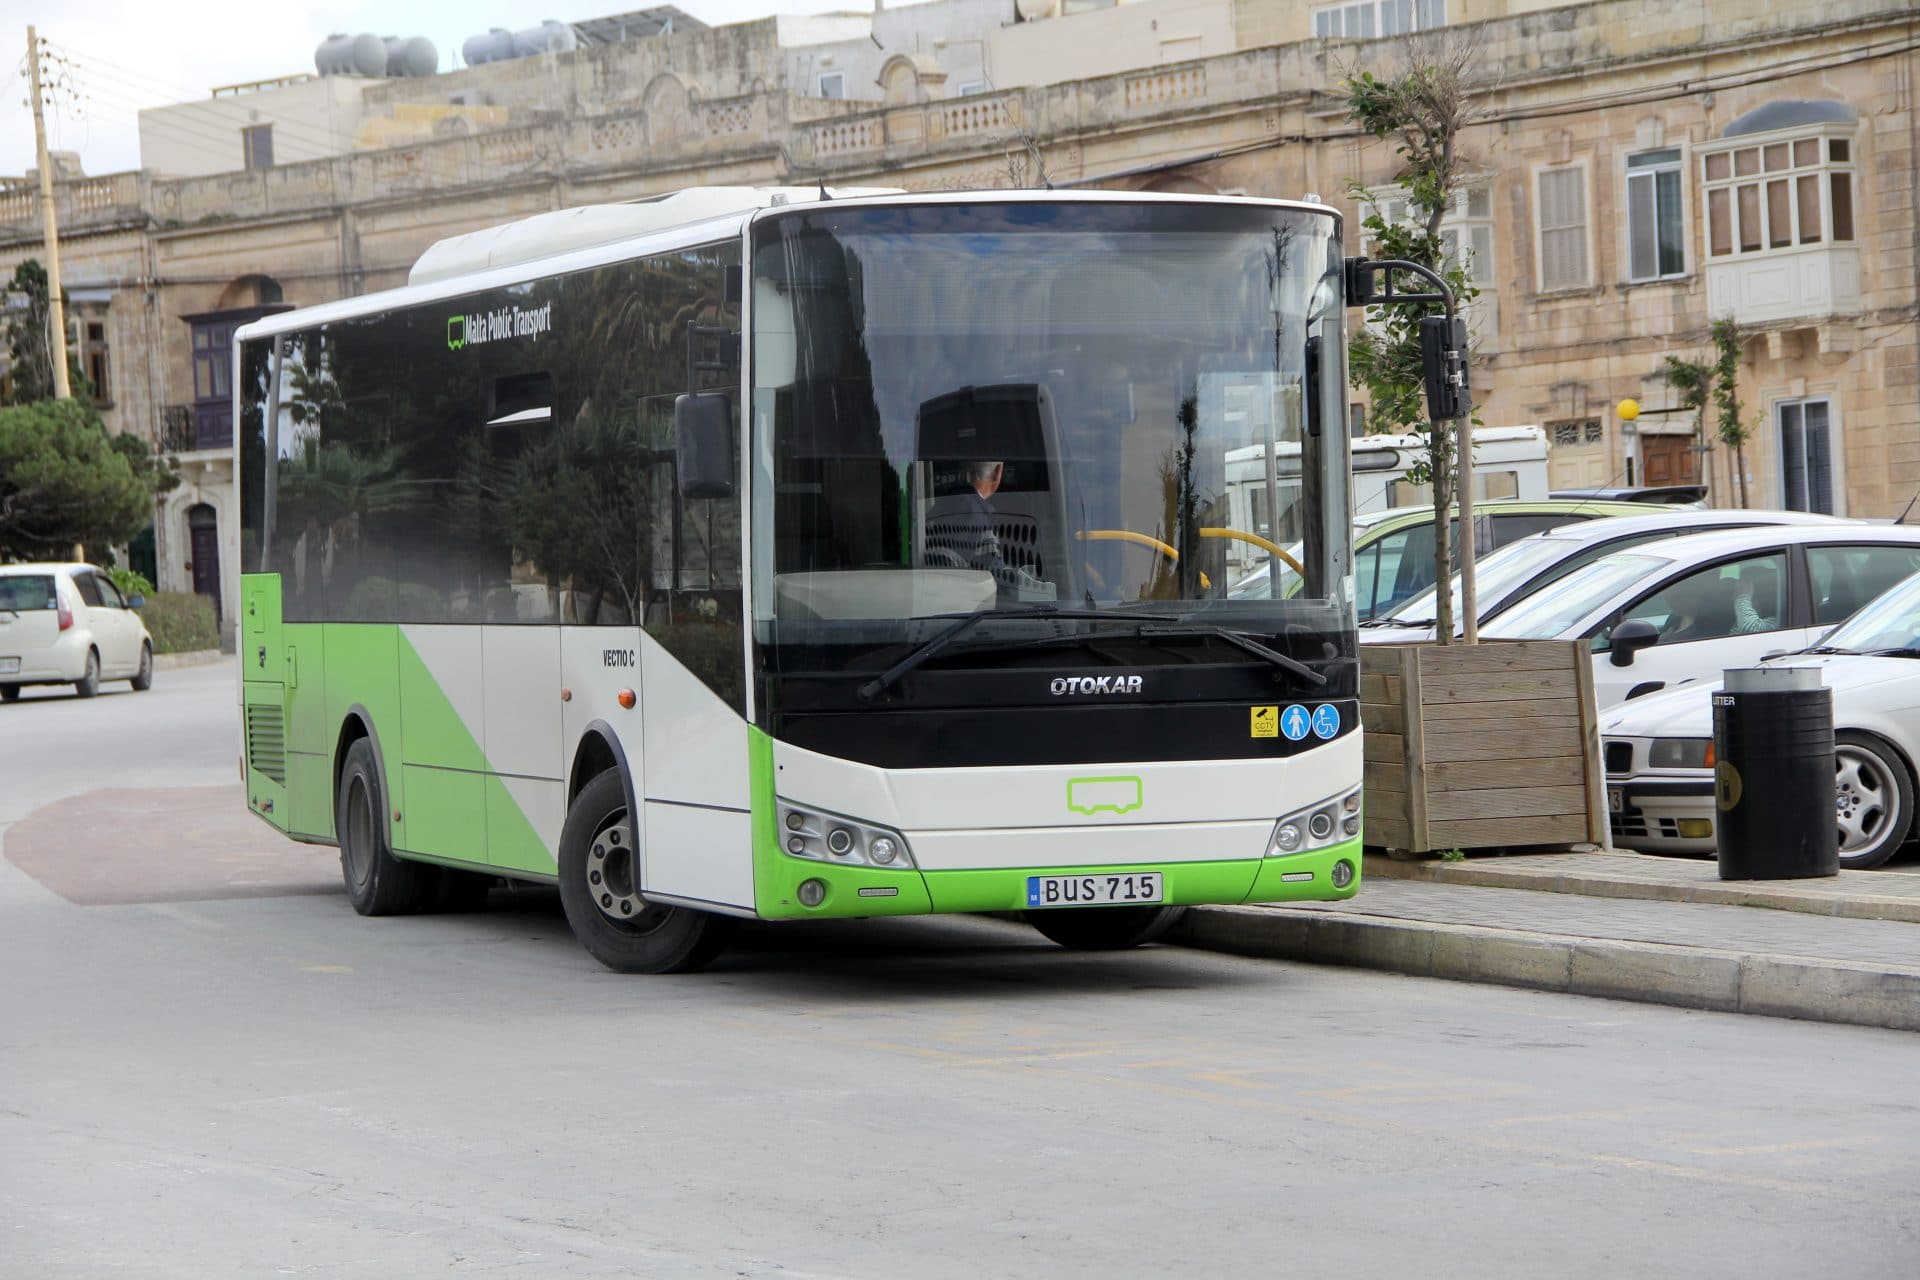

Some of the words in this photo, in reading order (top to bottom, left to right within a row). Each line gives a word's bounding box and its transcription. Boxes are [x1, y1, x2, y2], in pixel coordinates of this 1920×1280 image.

[465, 313, 487, 345] Malta
[488, 306, 512, 341] Public
[512, 300, 551, 342] Transport
[603, 649, 628, 667] VECTIO
[629, 649, 635, 667] C
[1050, 675, 1143, 695] OTOKAR
[1255, 722, 1274, 730] CCTV
[1046, 878, 1096, 903] BUS
[1107, 876, 1154, 900] 715
